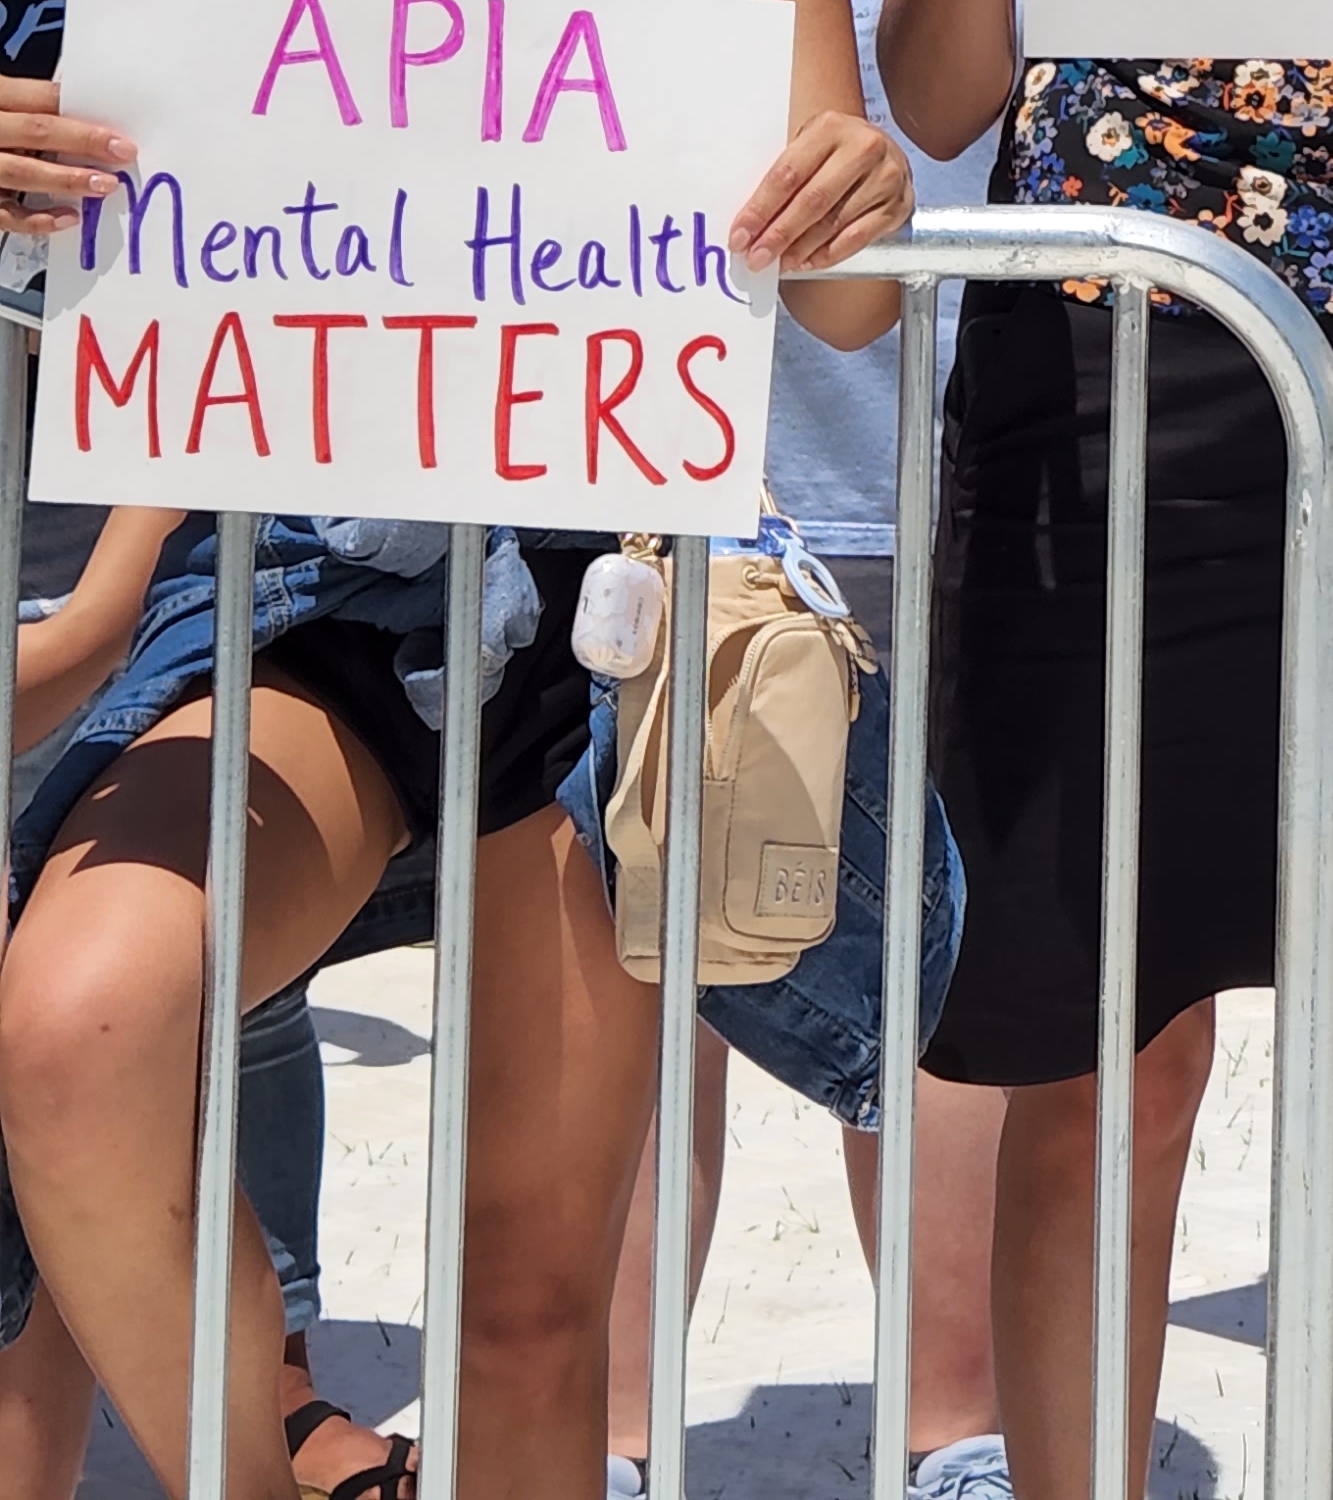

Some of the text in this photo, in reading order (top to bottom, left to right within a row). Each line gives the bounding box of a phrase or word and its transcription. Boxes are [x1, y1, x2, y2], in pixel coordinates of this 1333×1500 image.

[79, 170, 754, 305] Mental Health
[75, 311, 735, 485] MATTERS
[775, 861, 827, 904] BÉIS
